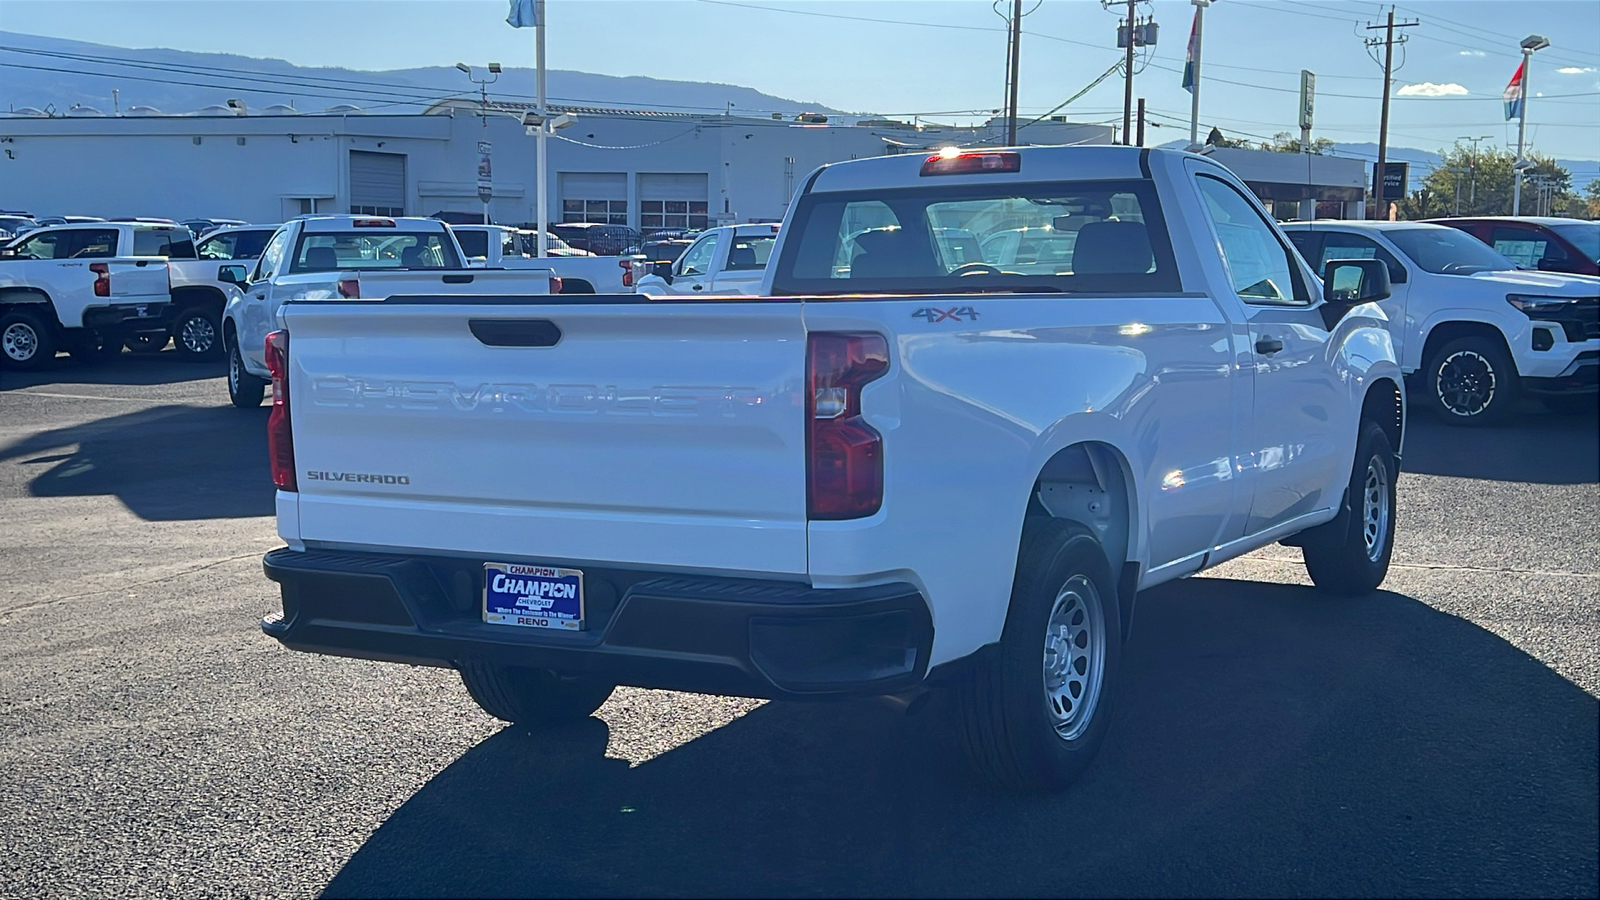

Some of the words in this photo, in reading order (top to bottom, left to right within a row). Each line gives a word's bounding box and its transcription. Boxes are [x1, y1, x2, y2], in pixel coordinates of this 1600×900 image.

[311, 375, 757, 418] CHEVROLET
[307, 470, 410, 485] SILVERADO
[510, 566, 555, 576] CHAMPION
[492, 574, 576, 598] CHAMPION
[518, 598, 552, 606] CHEVROLET
[517, 617, 549, 627] RENO
